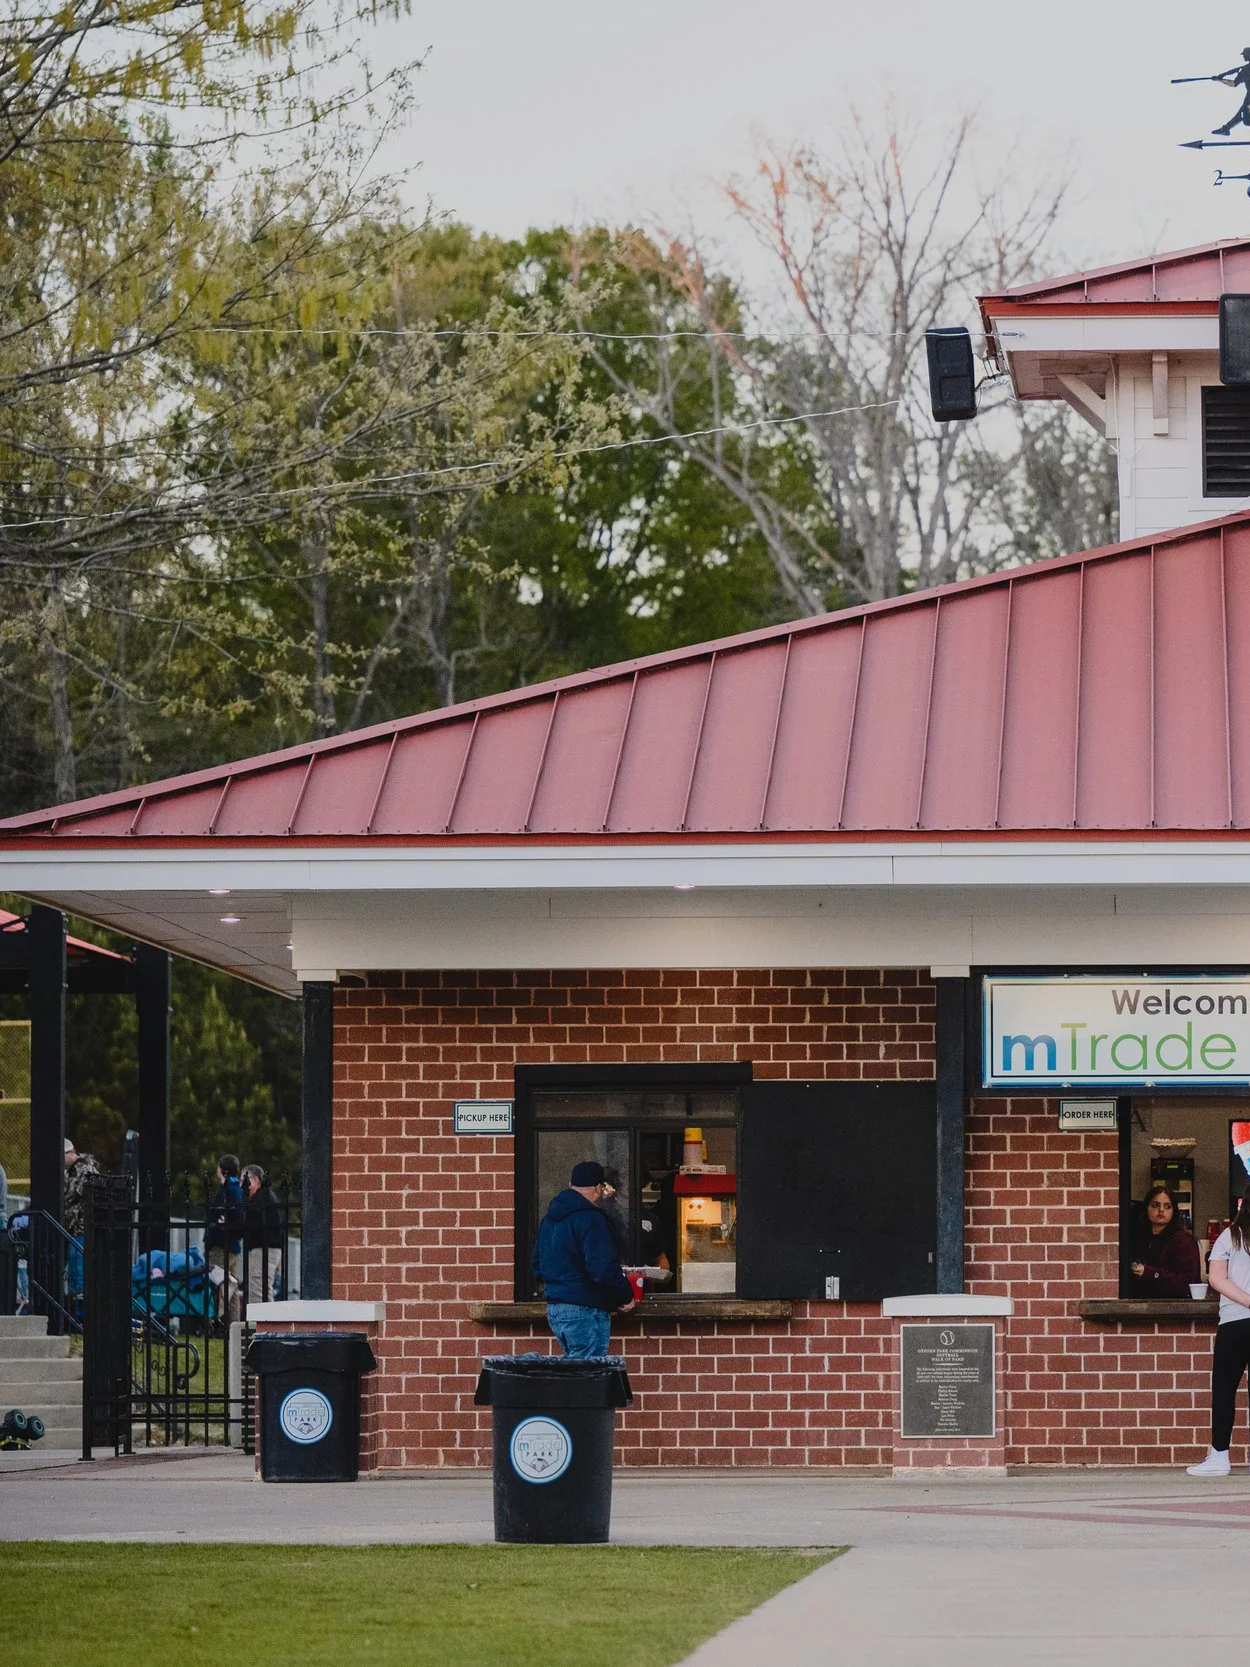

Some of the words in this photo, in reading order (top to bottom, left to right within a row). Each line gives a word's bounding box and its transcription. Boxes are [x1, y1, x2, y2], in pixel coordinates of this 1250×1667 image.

[1002, 1021, 1237, 1071] mTrade
[459, 1114, 487, 1122] PICKUP
[489, 1114, 508, 1122] HERE
[1064, 1110, 1091, 1119] ORDER
[1093, 1110, 1113, 1119] HERE
